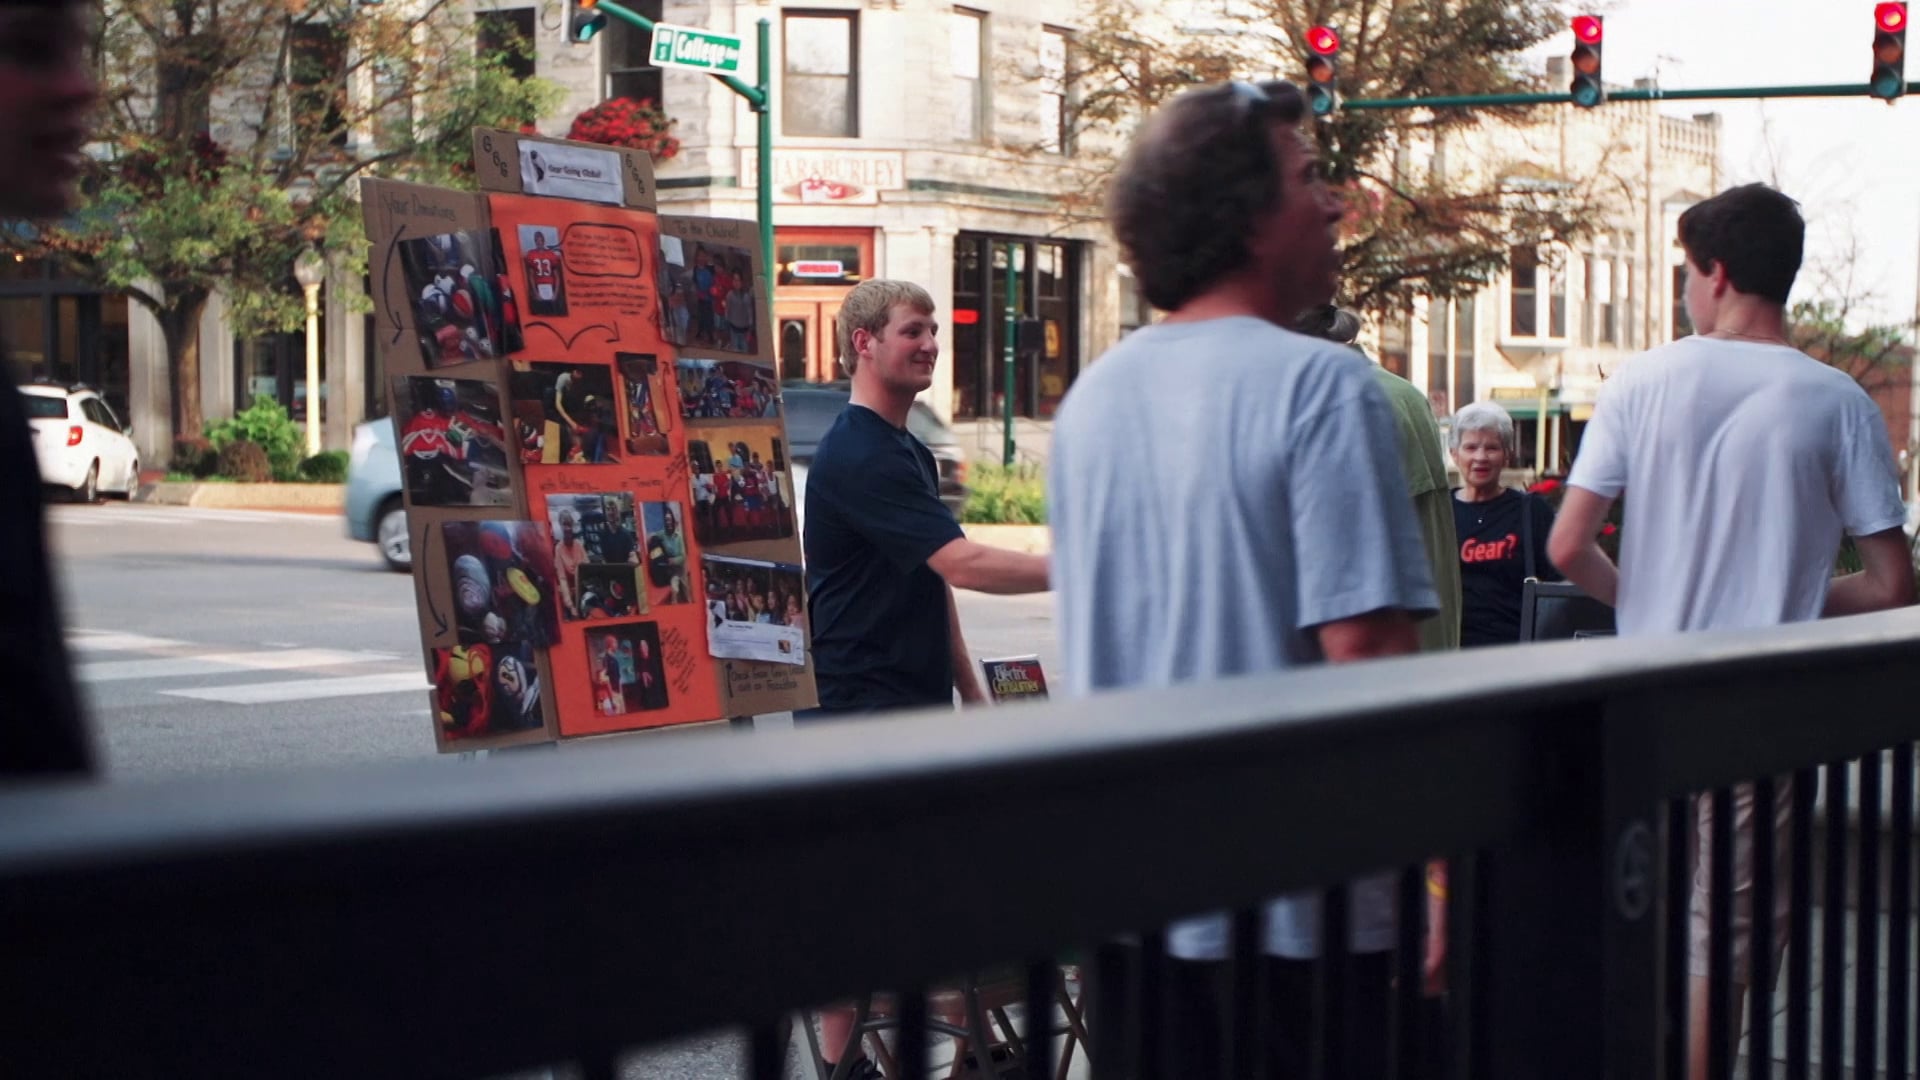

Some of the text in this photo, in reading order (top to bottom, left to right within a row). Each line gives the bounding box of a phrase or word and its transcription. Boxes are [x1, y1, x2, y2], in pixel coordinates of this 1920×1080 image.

[677, 33, 725, 67] College
[823, 158, 897, 186] BURLEY
[1461, 533, 1518, 563] Gear?
[993, 664, 1029, 682] Electric
